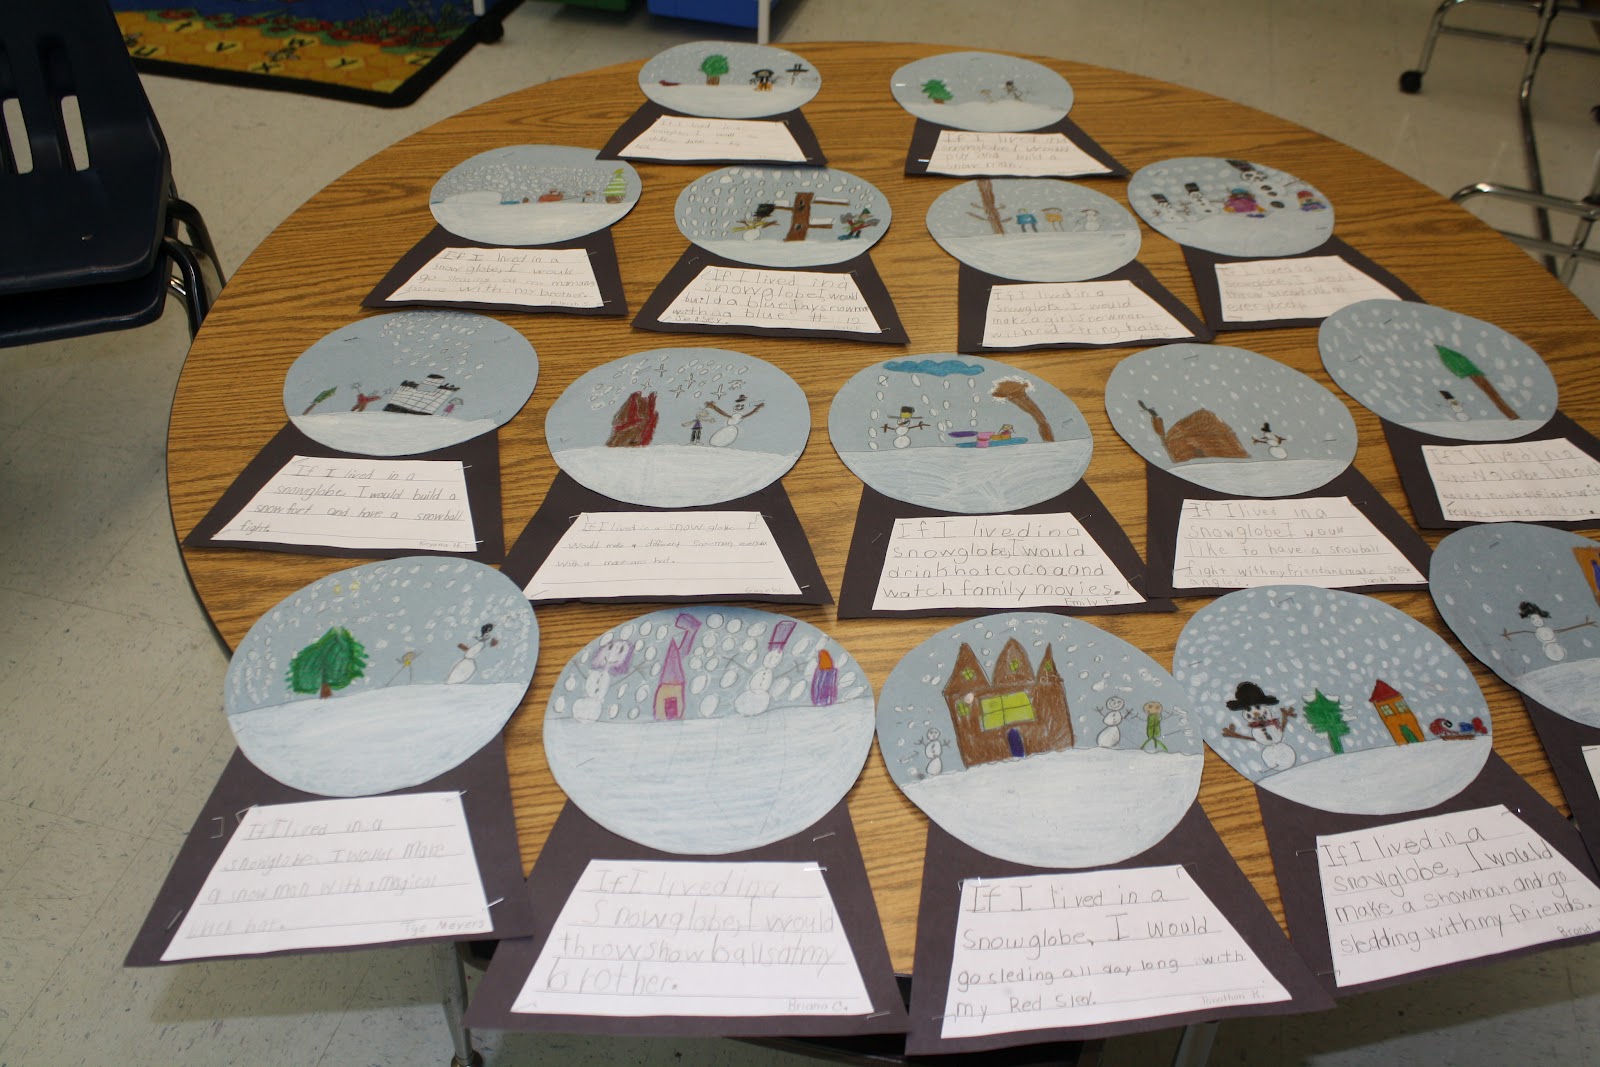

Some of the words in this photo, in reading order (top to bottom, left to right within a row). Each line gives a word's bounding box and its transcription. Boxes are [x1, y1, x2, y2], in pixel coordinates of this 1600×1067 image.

[757, 272, 796, 286] lived
[745, 308, 785, 321] blue
[296, 465, 320, 477] If
[325, 468, 340, 478] I
[343, 468, 373, 480] lived
[387, 471, 399, 481] in
[406, 473, 416, 481] a
[368, 488, 405, 499] would
[412, 488, 443, 501] build
[287, 503, 314, 516] fort
[328, 506, 350, 518] and
[356, 507, 384, 519] have
[417, 509, 464, 521] snowball
[1189, 502, 1213, 517] If
[1221, 503, 1236, 517] I
[240, 520, 270, 536] fight.
[899, 521, 927, 538] If
[937, 520, 956, 537] I
[1022, 543, 1086, 558] would
[1241, 546, 1259, 556] to
[1268, 543, 1304, 555] have
[1311, 547, 1321, 555] a
[888, 561, 949, 579] drink
[955, 563, 991, 576] hot
[1068, 562, 1104, 577] and
[883, 582, 953, 598] watch
[963, 579, 1027, 601] family
[1035, 581, 1121, 597] movies.
[346, 820, 362, 833] in
[331, 849, 346, 864] I
[1320, 844, 1348, 868] If
[1350, 840, 1371, 862] I
[1373, 829, 1434, 859] lived
[1434, 828, 1458, 847] in
[1466, 826, 1487, 844] a
[1465, 843, 1492, 873] I
[1483, 838, 1555, 868] would
[595, 868, 625, 894] If
[629, 868, 650, 894] I
[966, 884, 1002, 914] If
[1009, 884, 1033, 912] I
[1050, 883, 1104, 909] lived
[1118, 884, 1139, 906] in
[1151, 888, 1170, 904] a
[1334, 901, 1395, 924] make
[1402, 901, 1416, 914] a
[1513, 871, 1543, 892] and
[1548, 870, 1568, 899] go
[766, 908, 836, 933] would
[1105, 912, 1130, 942] I
[1340, 926, 1422, 954] sledding
[1424, 912, 1478, 941] with
[1478, 913, 1505, 939] my
[1508, 893, 1594, 923] friends.
[555, 931, 643, 962] throw
[545, 956, 679, 997] brother.
[957, 970, 982, 992] go
[1062, 963, 1092, 977] all
[1102, 961, 1133, 977] day
[1139, 956, 1180, 976] long
[1200, 951, 1246, 966] with
[955, 1001, 989, 1024] my
[1009, 994, 1043, 1014] Red
